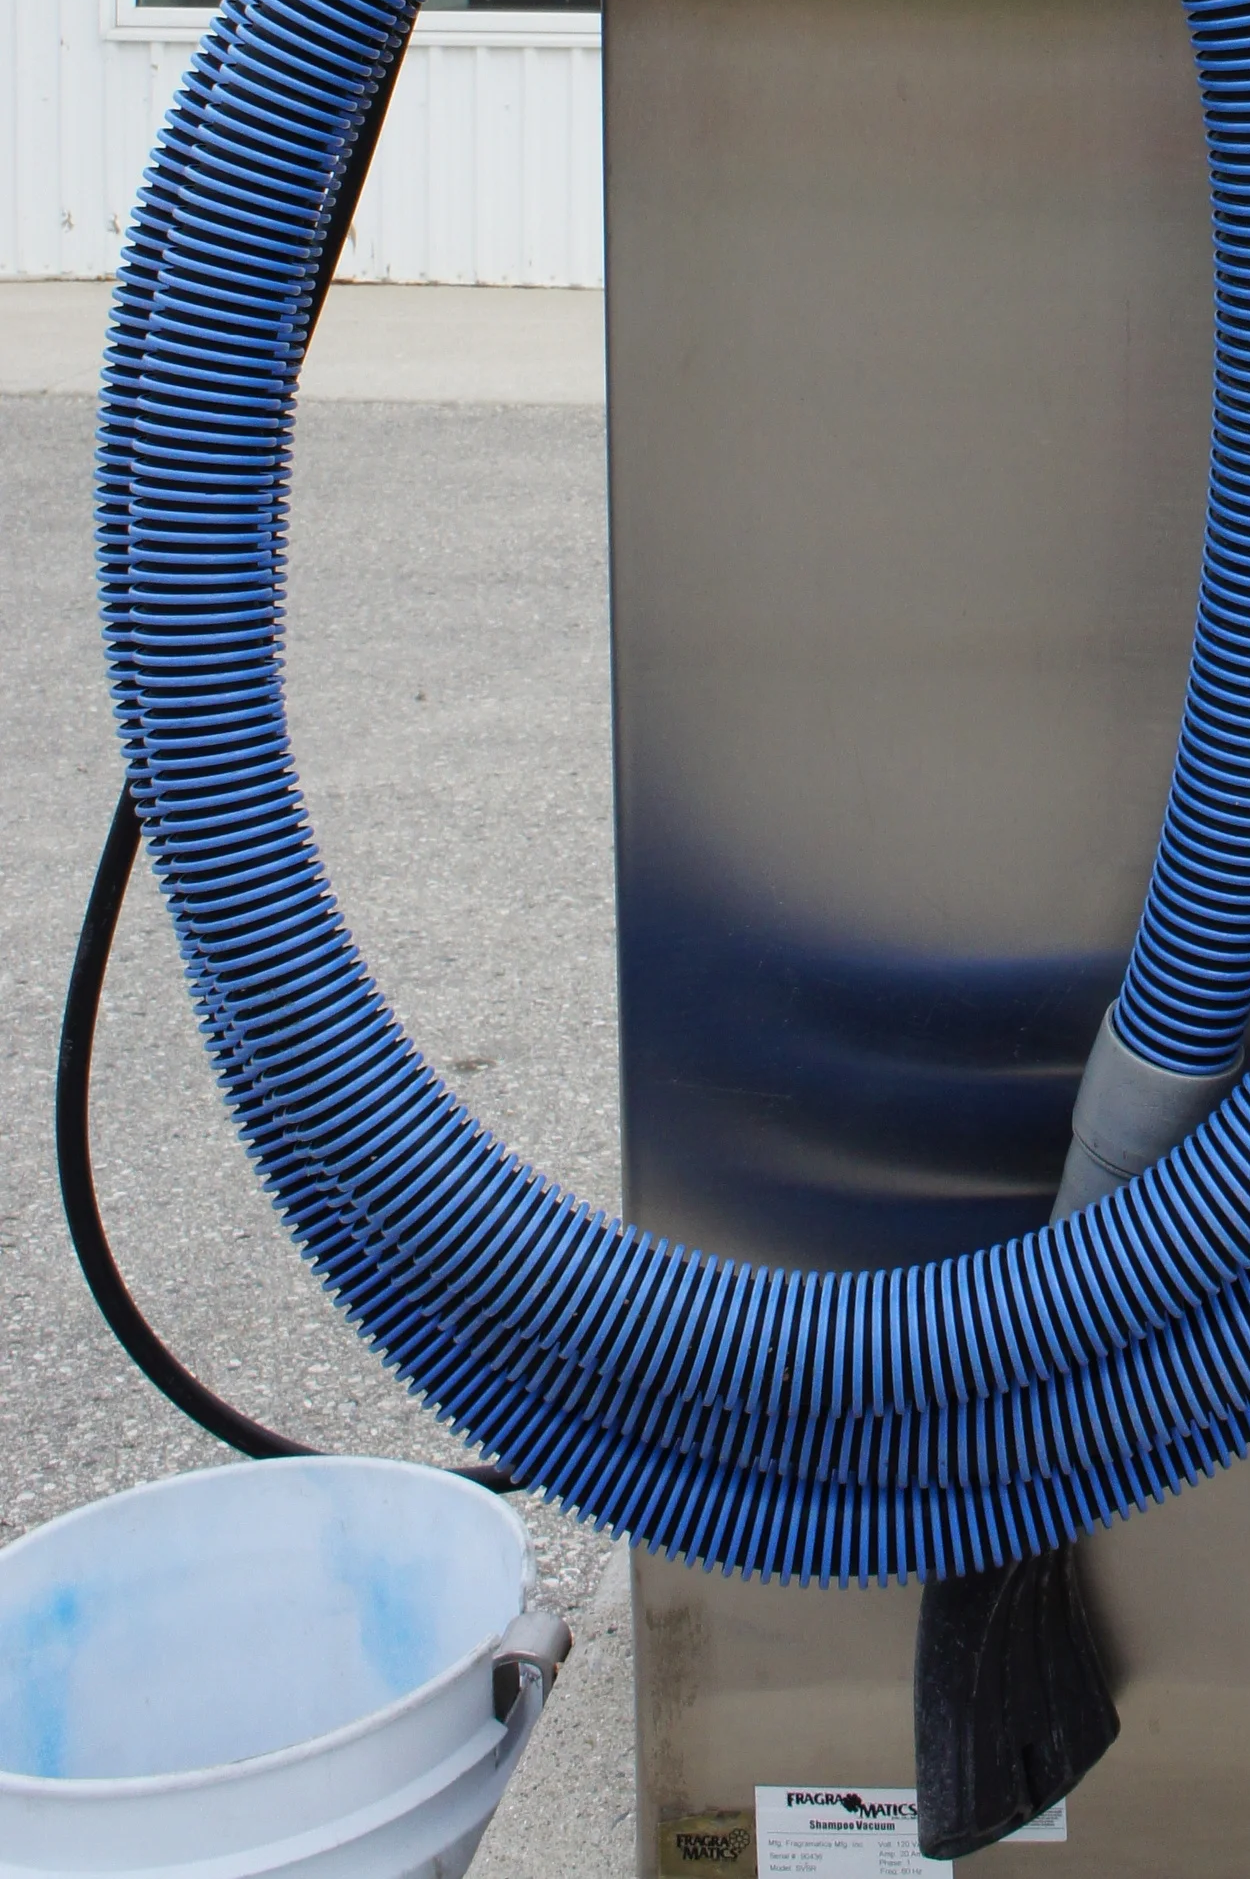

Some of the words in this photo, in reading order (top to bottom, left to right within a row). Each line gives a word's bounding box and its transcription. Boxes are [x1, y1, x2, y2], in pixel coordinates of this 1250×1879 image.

[786, 1792, 845, 1808] FRAGRA
[858, 1803, 919, 1819] MATICS
[809, 1819, 855, 1831] Shampoo
[856, 1820, 896, 1831] Vacuum
[675, 1833, 730, 1848] FRAGRA
[682, 1844, 742, 1861] MATICS
